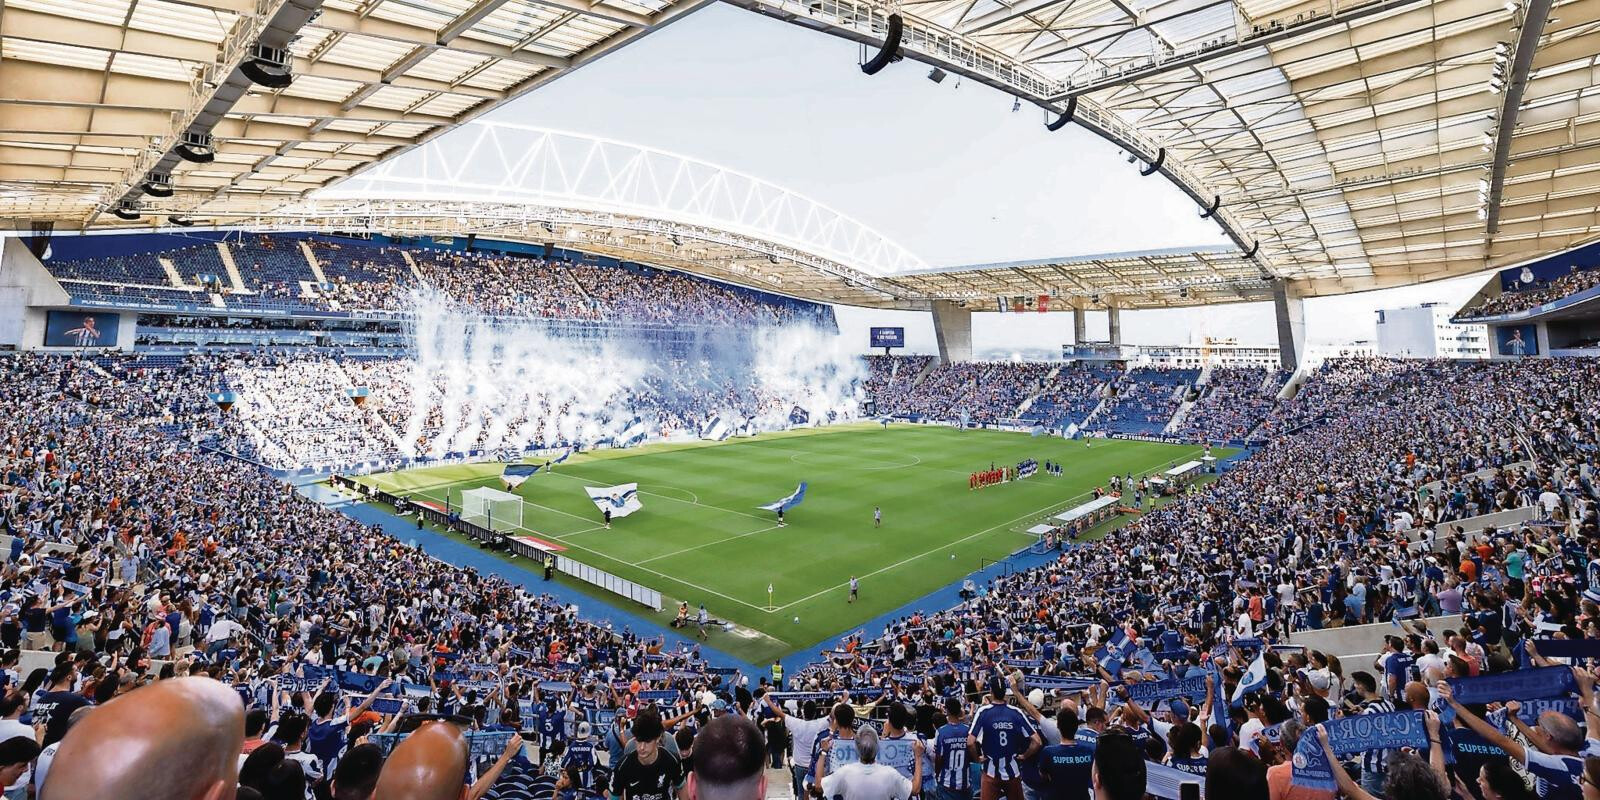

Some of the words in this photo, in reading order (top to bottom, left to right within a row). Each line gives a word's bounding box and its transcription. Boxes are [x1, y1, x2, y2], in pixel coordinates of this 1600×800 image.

[1000, 731, 1007, 746] 8
[1458, 743, 1488, 754] SUPER
[949, 750, 965, 771] 10
[1053, 755, 1074, 764] SUPER
[1074, 755, 1091, 764] BOCK
[1198, 765, 1207, 773] BO
